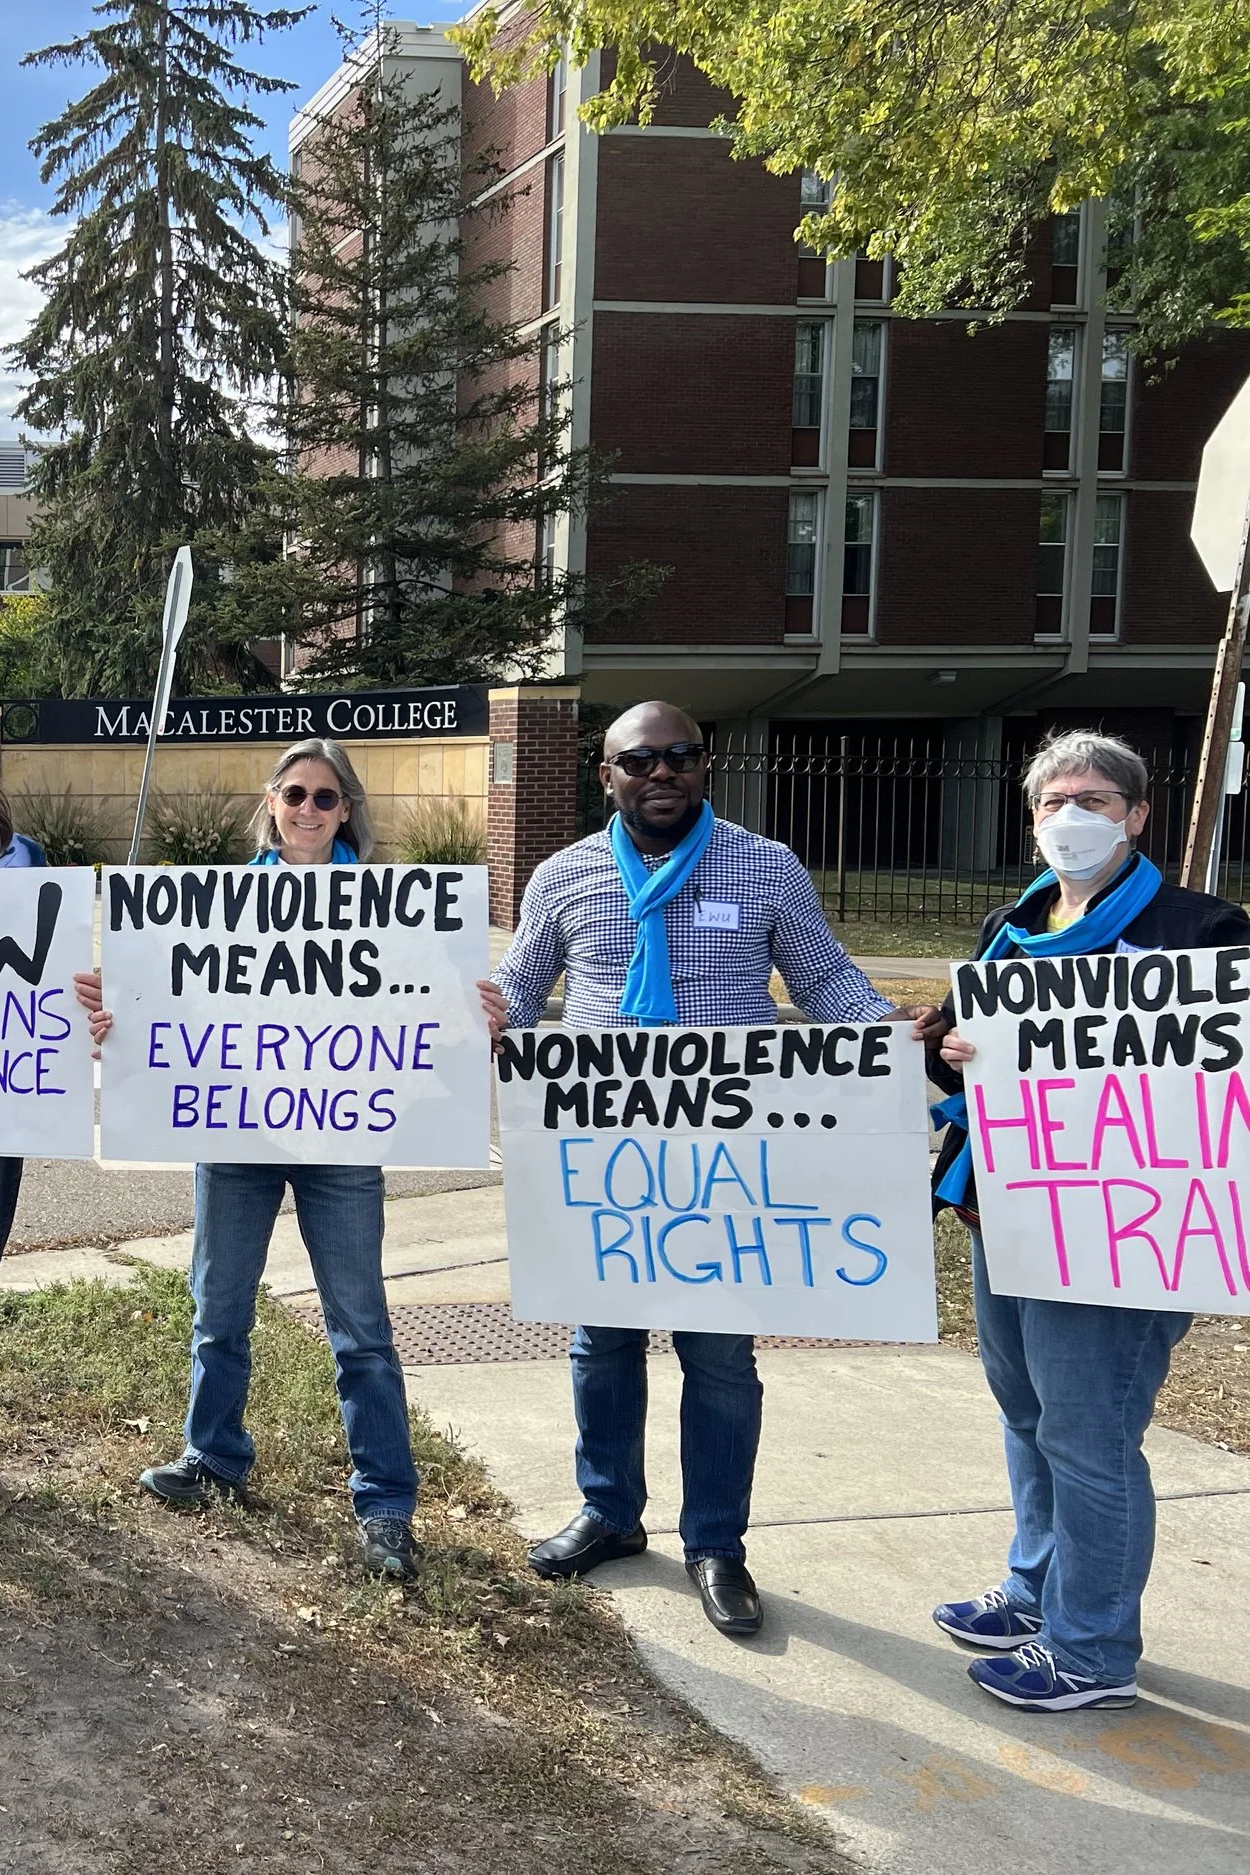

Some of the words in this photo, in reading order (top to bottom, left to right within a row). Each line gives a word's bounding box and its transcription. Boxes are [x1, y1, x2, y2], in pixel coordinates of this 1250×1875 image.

[326, 699, 458, 732] COLLEGE
[109, 868, 462, 933] NONVIOLENCE
[172, 939, 429, 997] MEANS...
[957, 947, 1250, 1019] NONVIOLE
[149, 1023, 439, 1071] EVERYONE
[496, 1026, 892, 1082] NONVIOLENCE
[1019, 1012, 1242, 1072] MEANS
[173, 1085, 396, 1132] BELONGS
[544, 1077, 836, 1129] MEANS...
[560, 1138, 818, 1210] EQUAL
[591, 1209, 887, 1287] RIGHTS
